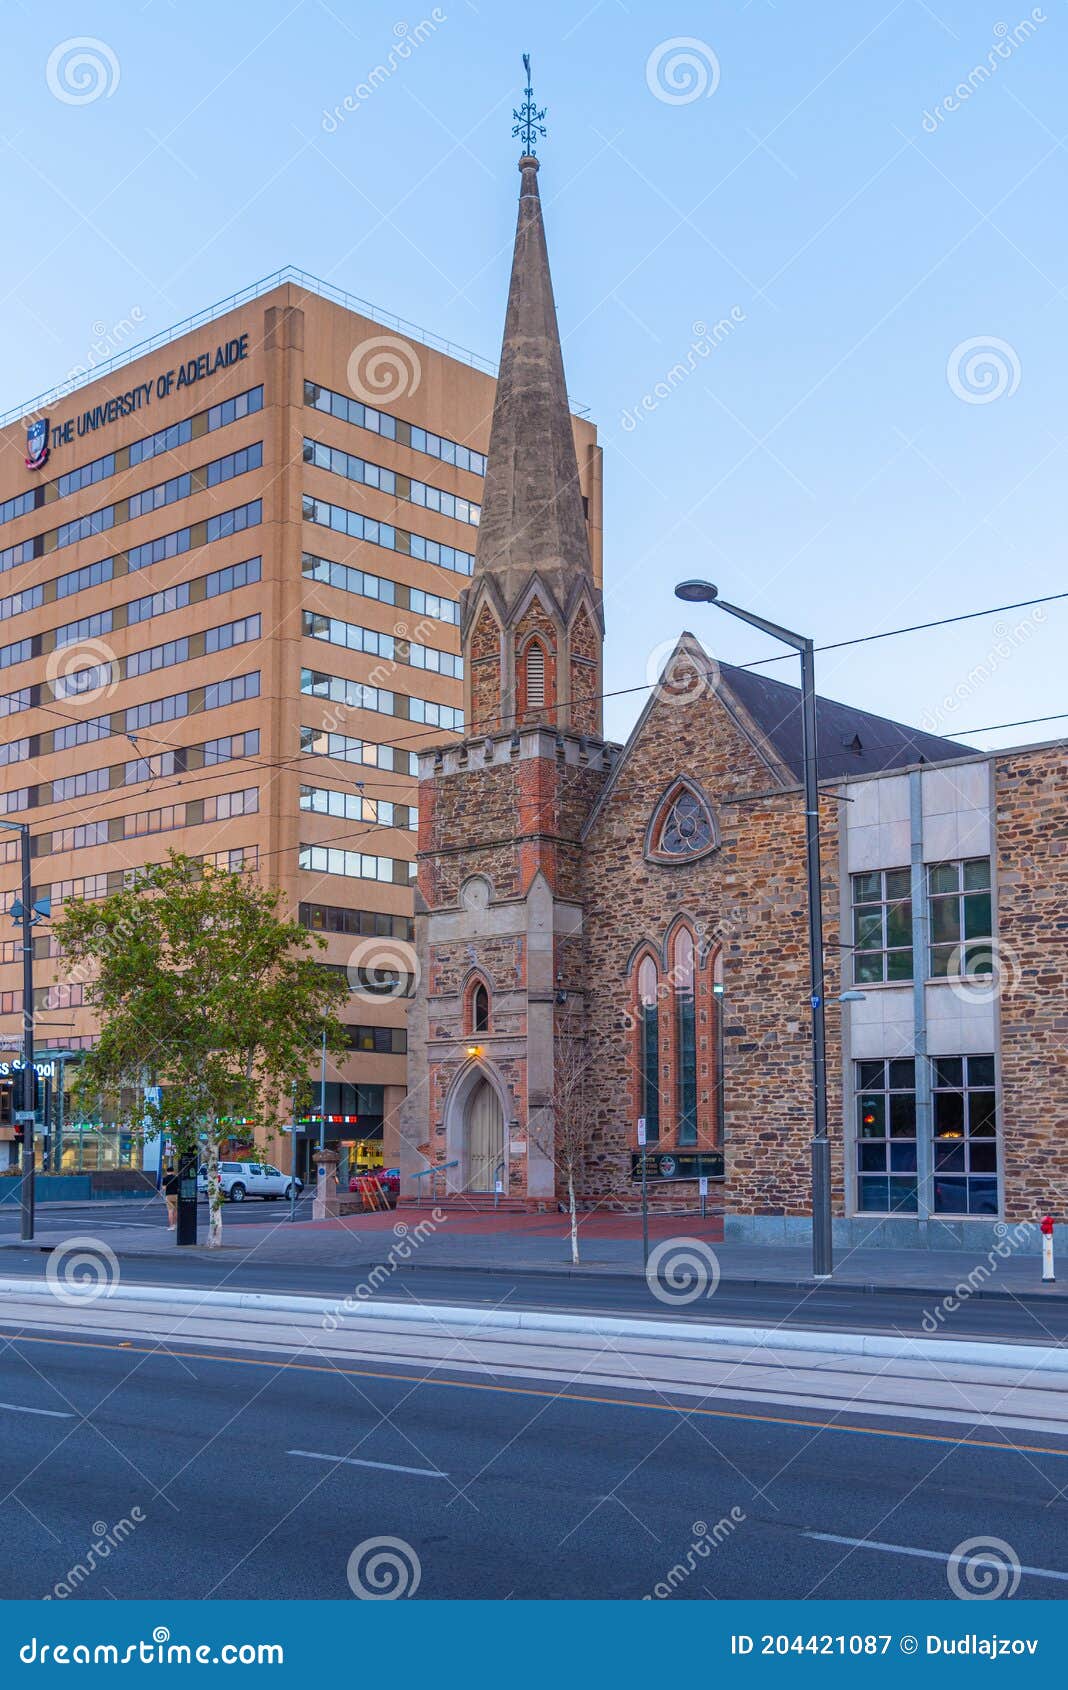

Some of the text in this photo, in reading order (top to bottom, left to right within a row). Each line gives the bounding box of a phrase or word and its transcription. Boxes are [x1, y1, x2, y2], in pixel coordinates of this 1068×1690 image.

[51, 333, 249, 449] THE UNIVERSITY OF ADELAIDE
[12, 1059, 55, 1077] Sool
